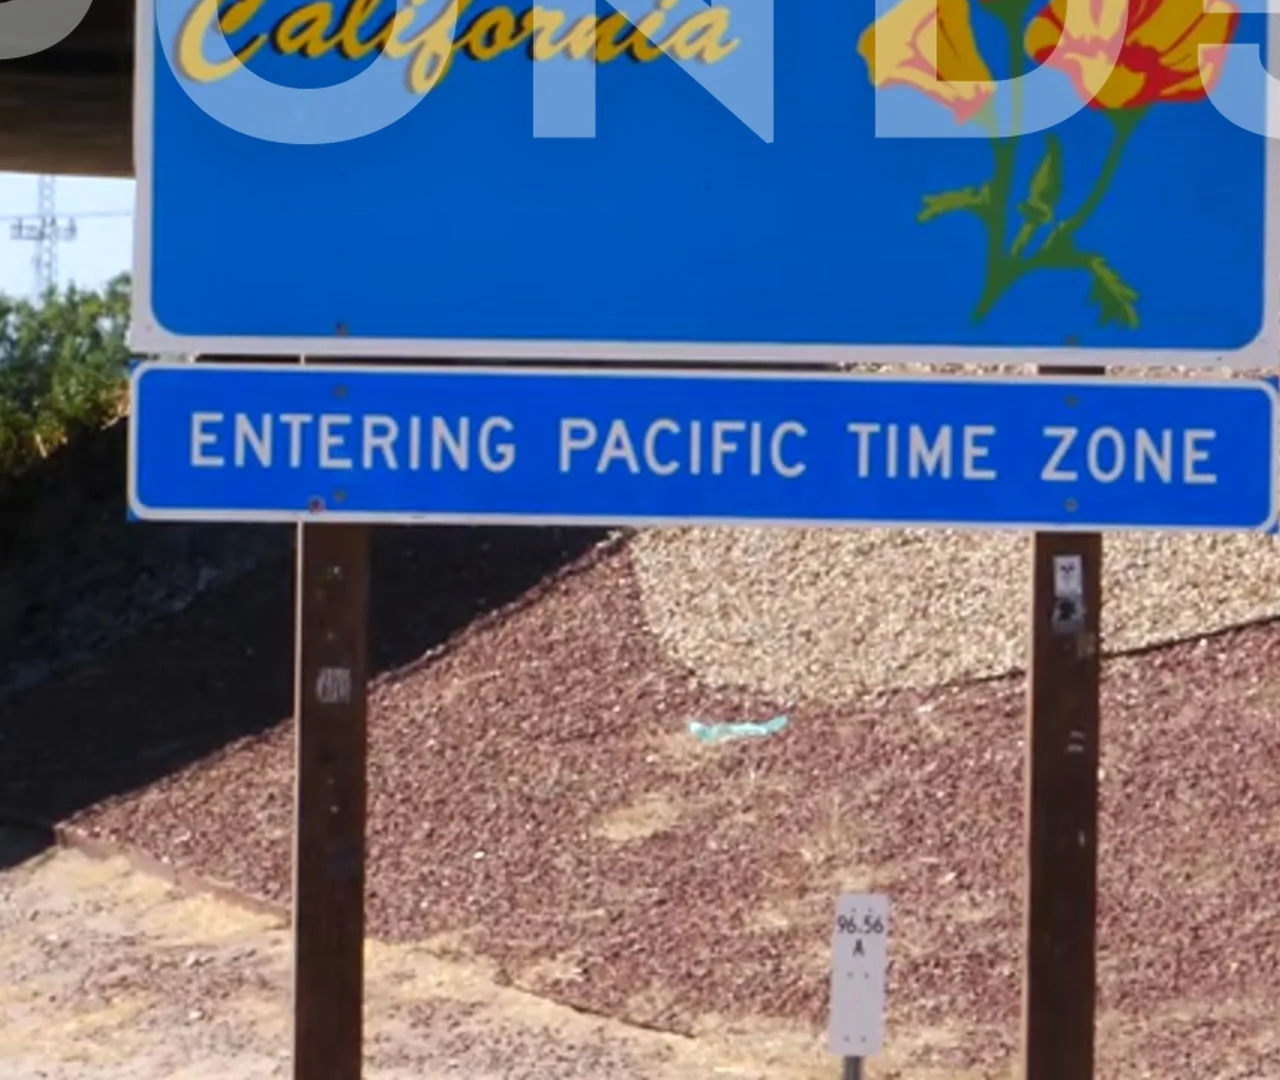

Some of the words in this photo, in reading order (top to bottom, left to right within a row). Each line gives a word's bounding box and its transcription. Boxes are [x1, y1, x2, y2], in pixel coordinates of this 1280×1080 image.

[188, 412, 516, 473] ENTERING
[558, 417, 808, 478] PACIFIC
[847, 422, 996, 480] TIME
[1041, 426, 1218, 485] ZONE
[837, 914, 884, 935] 96.56
[852, 937, 865, 957] A
